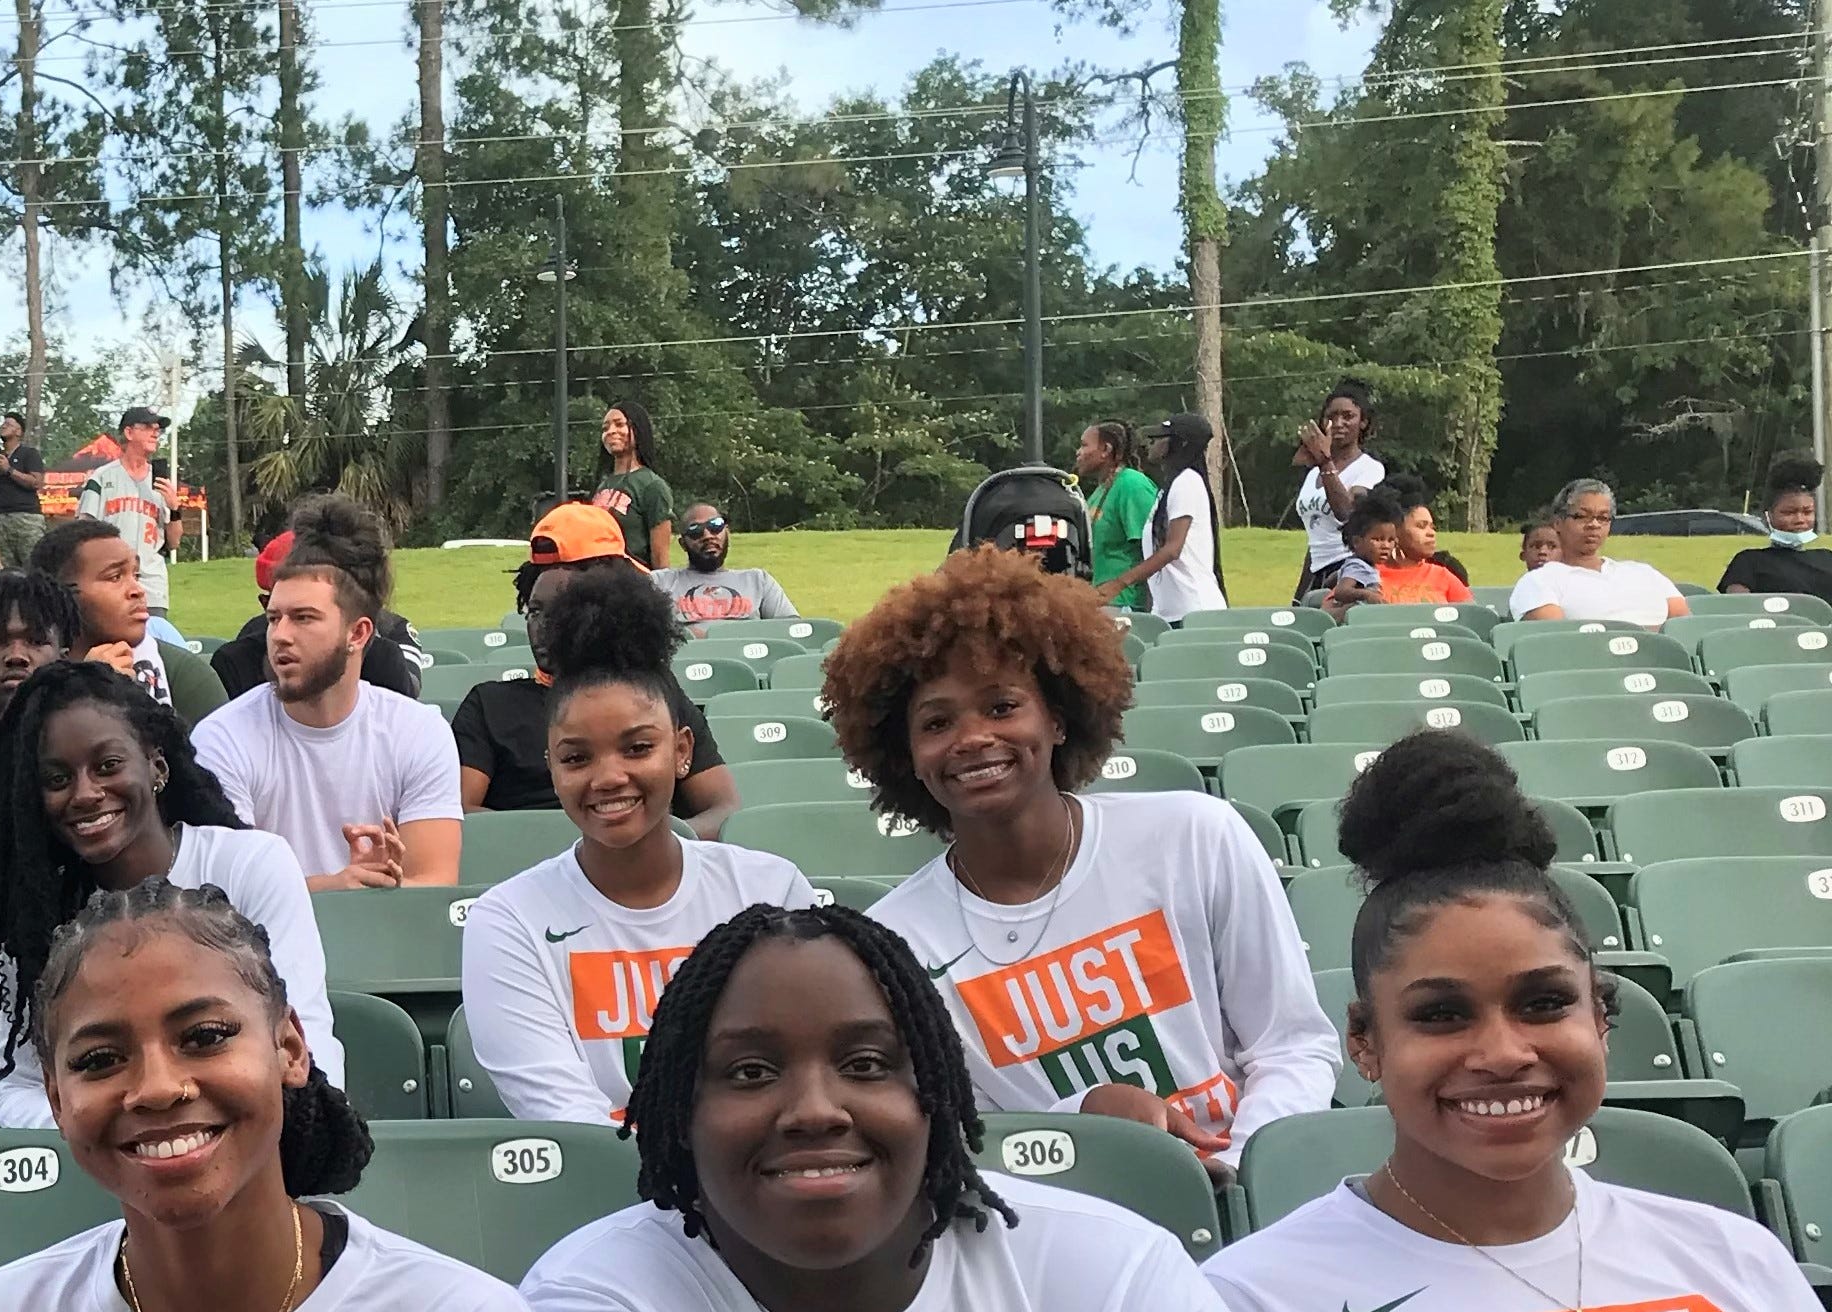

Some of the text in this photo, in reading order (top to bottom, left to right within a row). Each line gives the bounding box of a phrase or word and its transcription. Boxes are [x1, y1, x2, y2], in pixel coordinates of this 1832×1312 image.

[1298, 496, 1331, 516] AMU
[691, 667, 708, 677] 310
[1223, 687, 1241, 699] 312
[1434, 712, 1455, 724] 312
[1660, 706, 1682, 718] 313
[1208, 717, 1227, 728] 311
[759, 726, 781, 738] 309
[1616, 753, 1638, 766] 312
[1107, 760, 1130, 775] 310
[1790, 803, 1815, 817] 311
[597, 956, 690, 1034] JU
[1002, 928, 1154, 1058] JUST
[1013, 1138, 1064, 1167] 306
[503, 1147, 551, 1175] 305
[2, 1155, 49, 1185] 304
